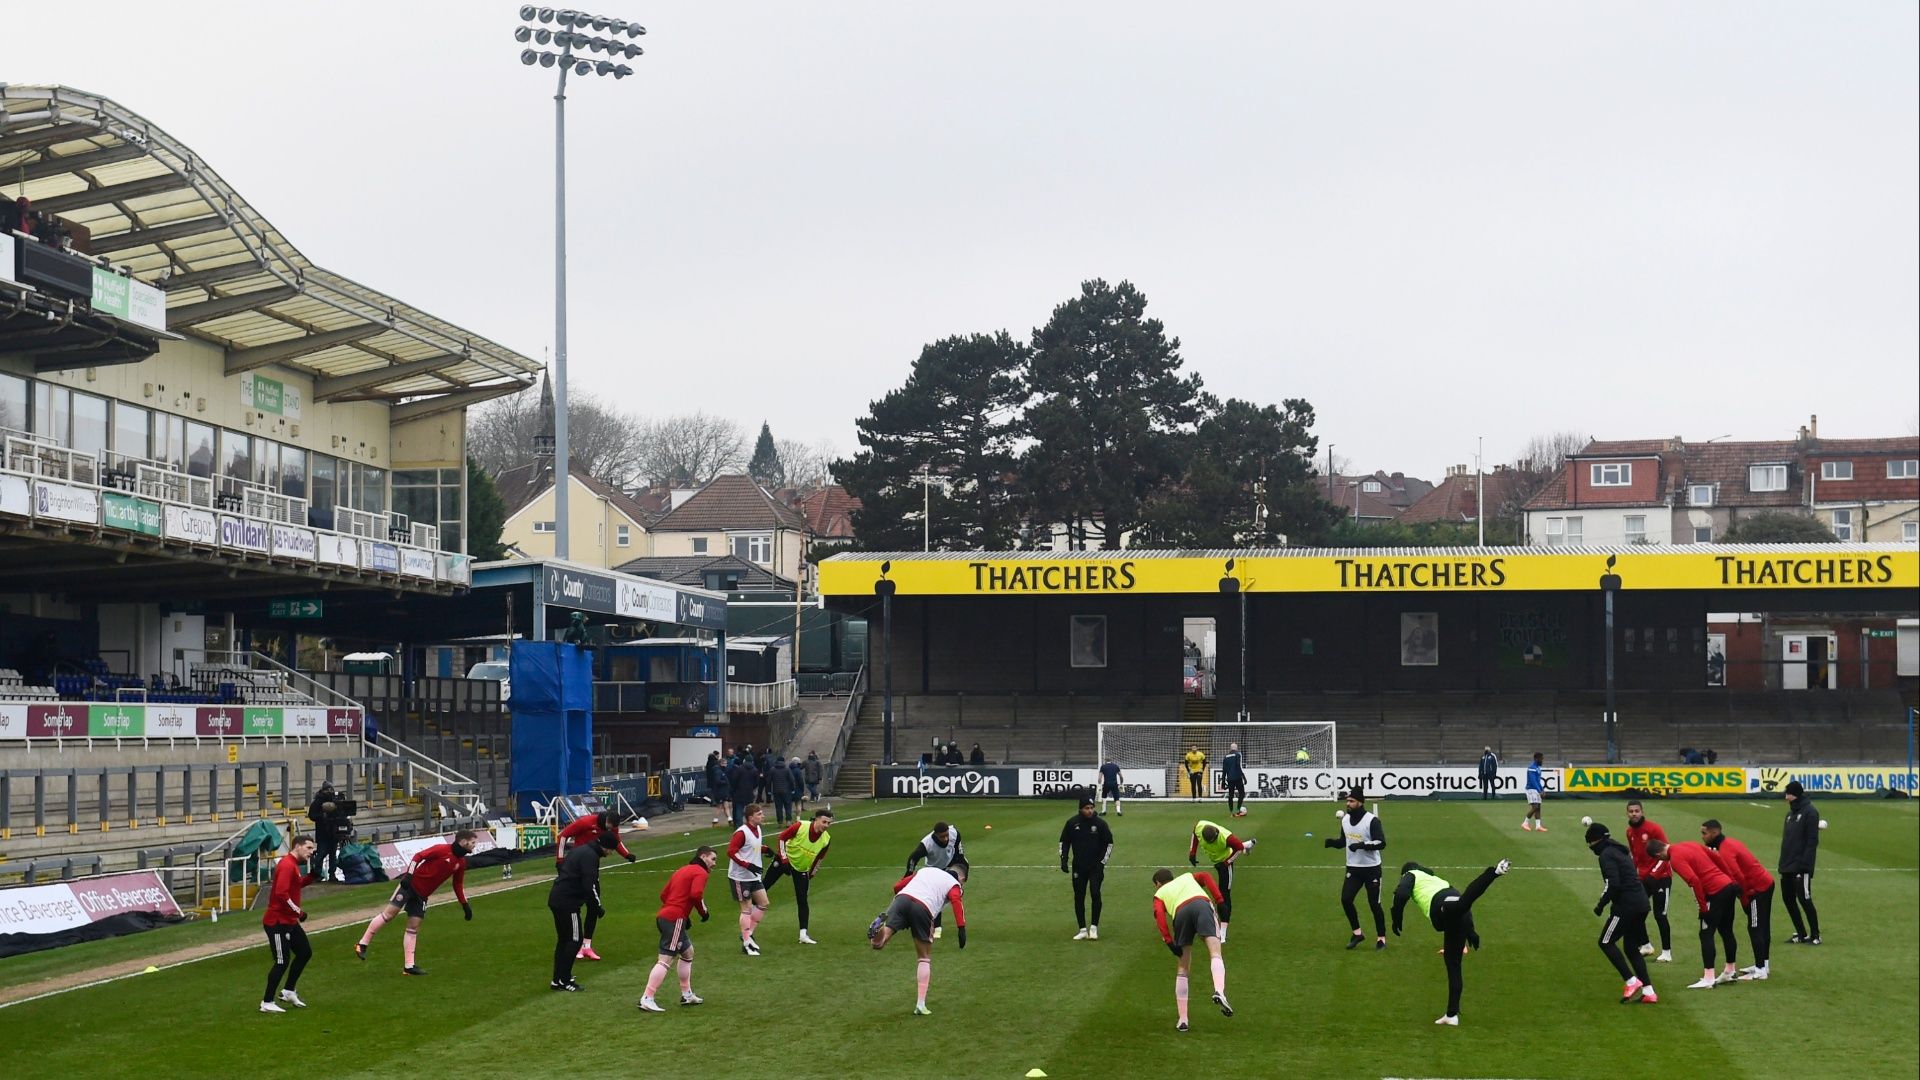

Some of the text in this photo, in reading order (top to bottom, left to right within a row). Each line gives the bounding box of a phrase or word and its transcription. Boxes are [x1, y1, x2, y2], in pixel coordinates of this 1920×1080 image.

[285, 393, 299, 410] STAND
[969, 562, 1136, 590] THATCHERS
[1335, 558, 1506, 588] THATCHERS
[1715, 555, 1893, 585] THATCHERS
[296, 714, 316, 729] Somelap
[893, 771, 1000, 794] macron
[1033, 770, 1073, 782] BBC
[1257, 772, 1518, 790] Barrs Court Constructon
[1569, 769, 1743, 787] ANDERSONS
[1789, 773, 1843, 791] AHIMSA
[1847, 773, 1885, 791] YOGA
[518, 835, 549, 850] EXIT
[80, 886, 167, 913] Office Beverages
[17, 898, 82, 922] Beverages
